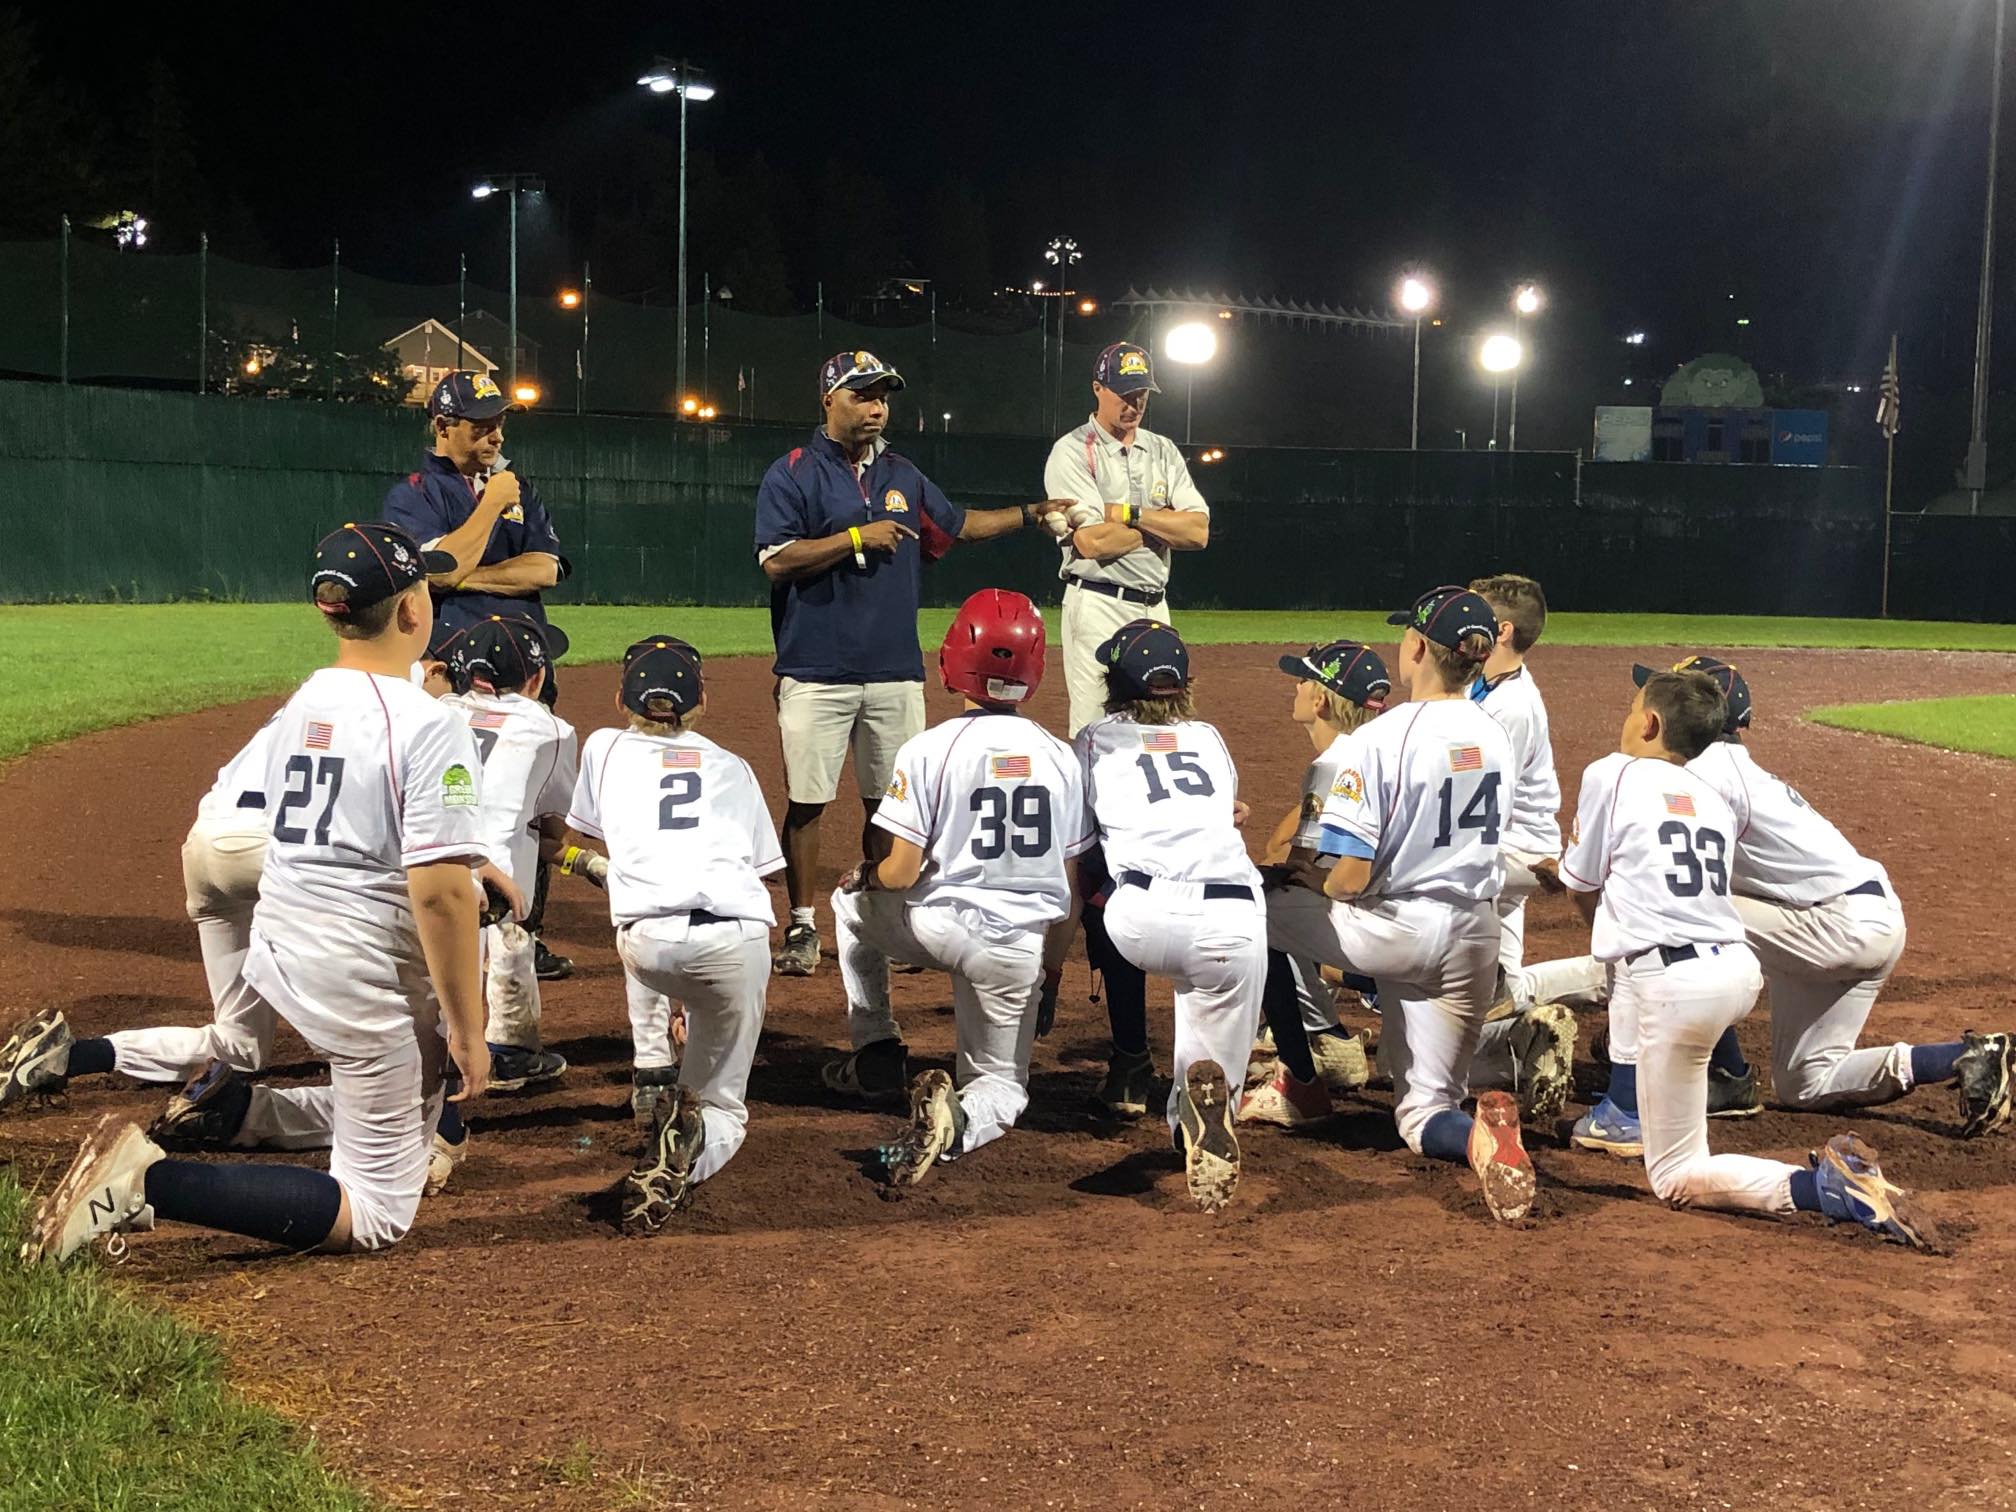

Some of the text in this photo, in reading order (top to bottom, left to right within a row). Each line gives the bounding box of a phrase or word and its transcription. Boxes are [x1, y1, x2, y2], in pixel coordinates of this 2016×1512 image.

[274, 755, 345, 846] 27
[658, 772, 702, 830] 2
[1135, 751, 1216, 804] 15
[1432, 771, 1502, 849] 14
[969, 785, 1052, 860] 39
[89, 1186, 115, 1226] N
